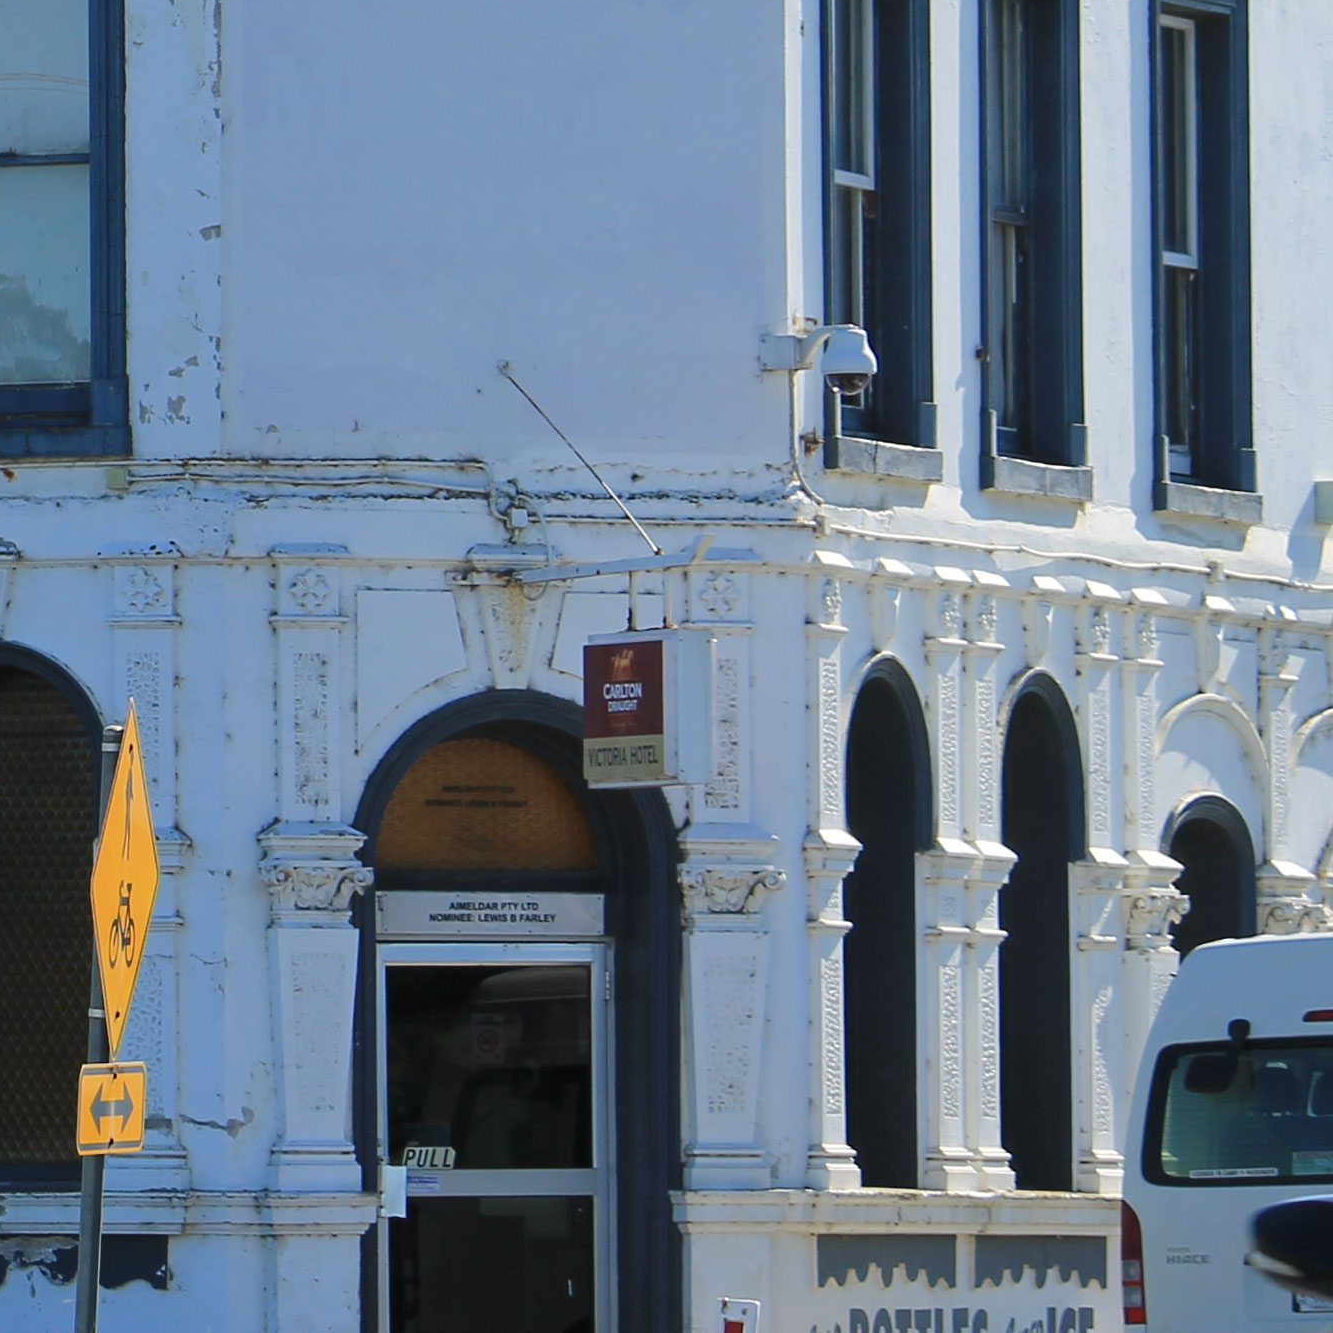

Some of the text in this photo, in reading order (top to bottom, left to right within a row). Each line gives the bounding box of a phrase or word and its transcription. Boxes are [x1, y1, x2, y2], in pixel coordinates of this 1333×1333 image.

[603, 682, 642, 699] CARLTON
[588, 744, 658, 767] VICTORIA HOTEL
[449, 902, 539, 911] AIMELDAR PTY LTD
[429, 913, 556, 922] NOMINEE: LEWIS B FARLEY
[404, 1148, 451, 1168] PULL
